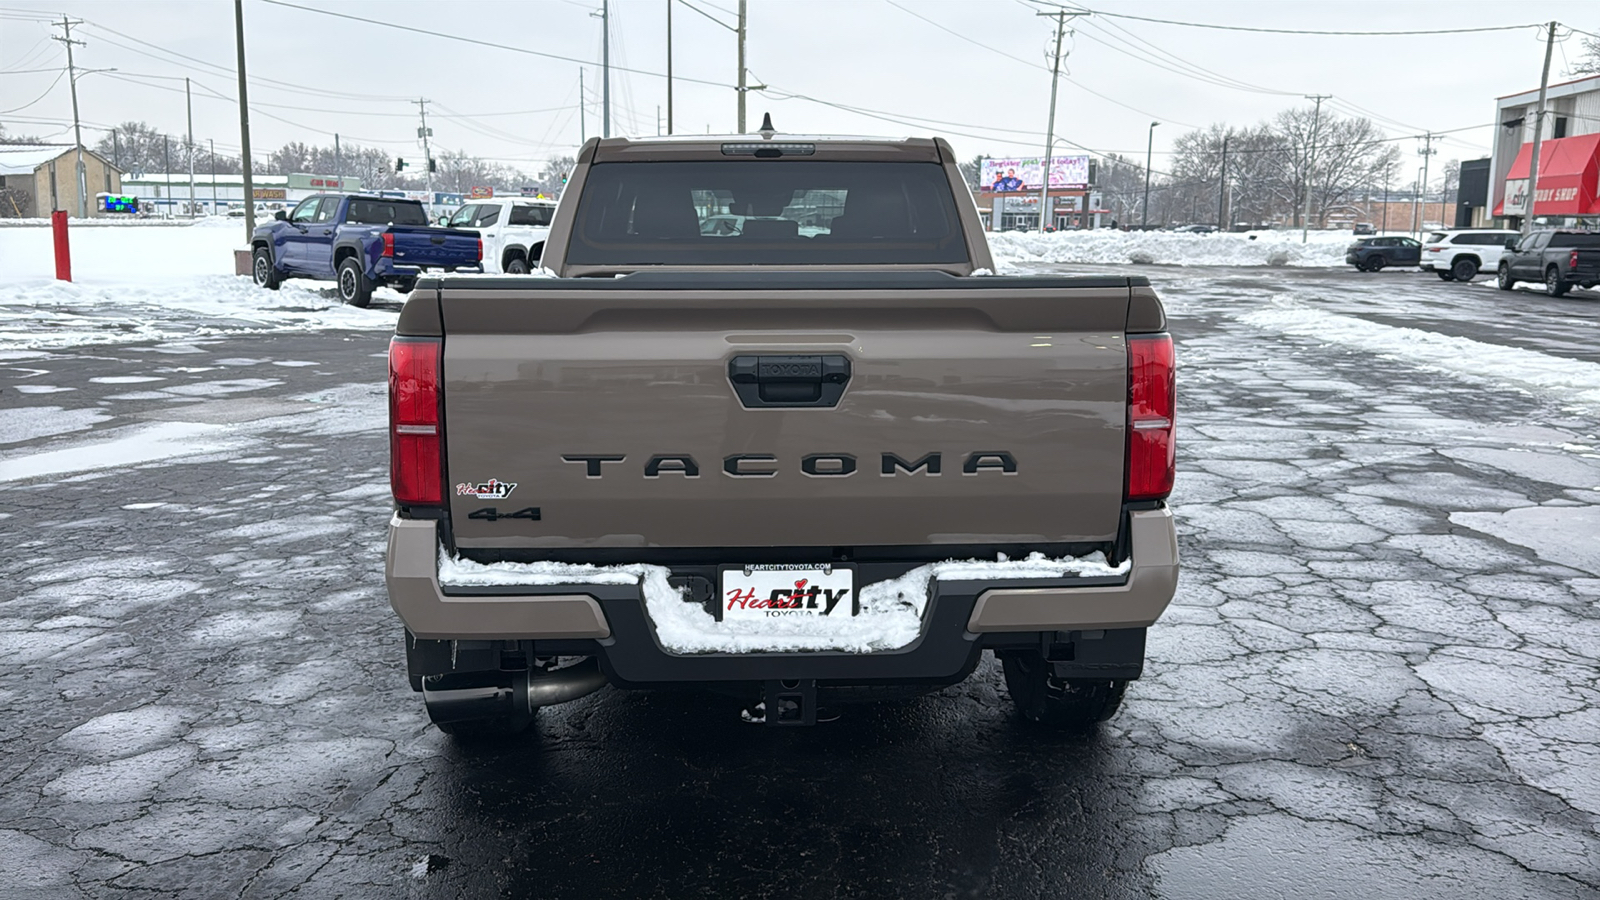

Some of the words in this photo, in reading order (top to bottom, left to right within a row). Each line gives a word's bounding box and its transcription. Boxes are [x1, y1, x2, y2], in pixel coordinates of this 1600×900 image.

[262, 190, 284, 198] WASH
[1554, 187, 1578, 201] SHOP
[761, 363, 820, 376] TOYOTA
[560, 452, 1018, 479] TACOMA
[744, 563, 832, 571] HEARTCITYTOYOTA.COM
[726, 587, 813, 611] Heart
[768, 579, 849, 616] city
